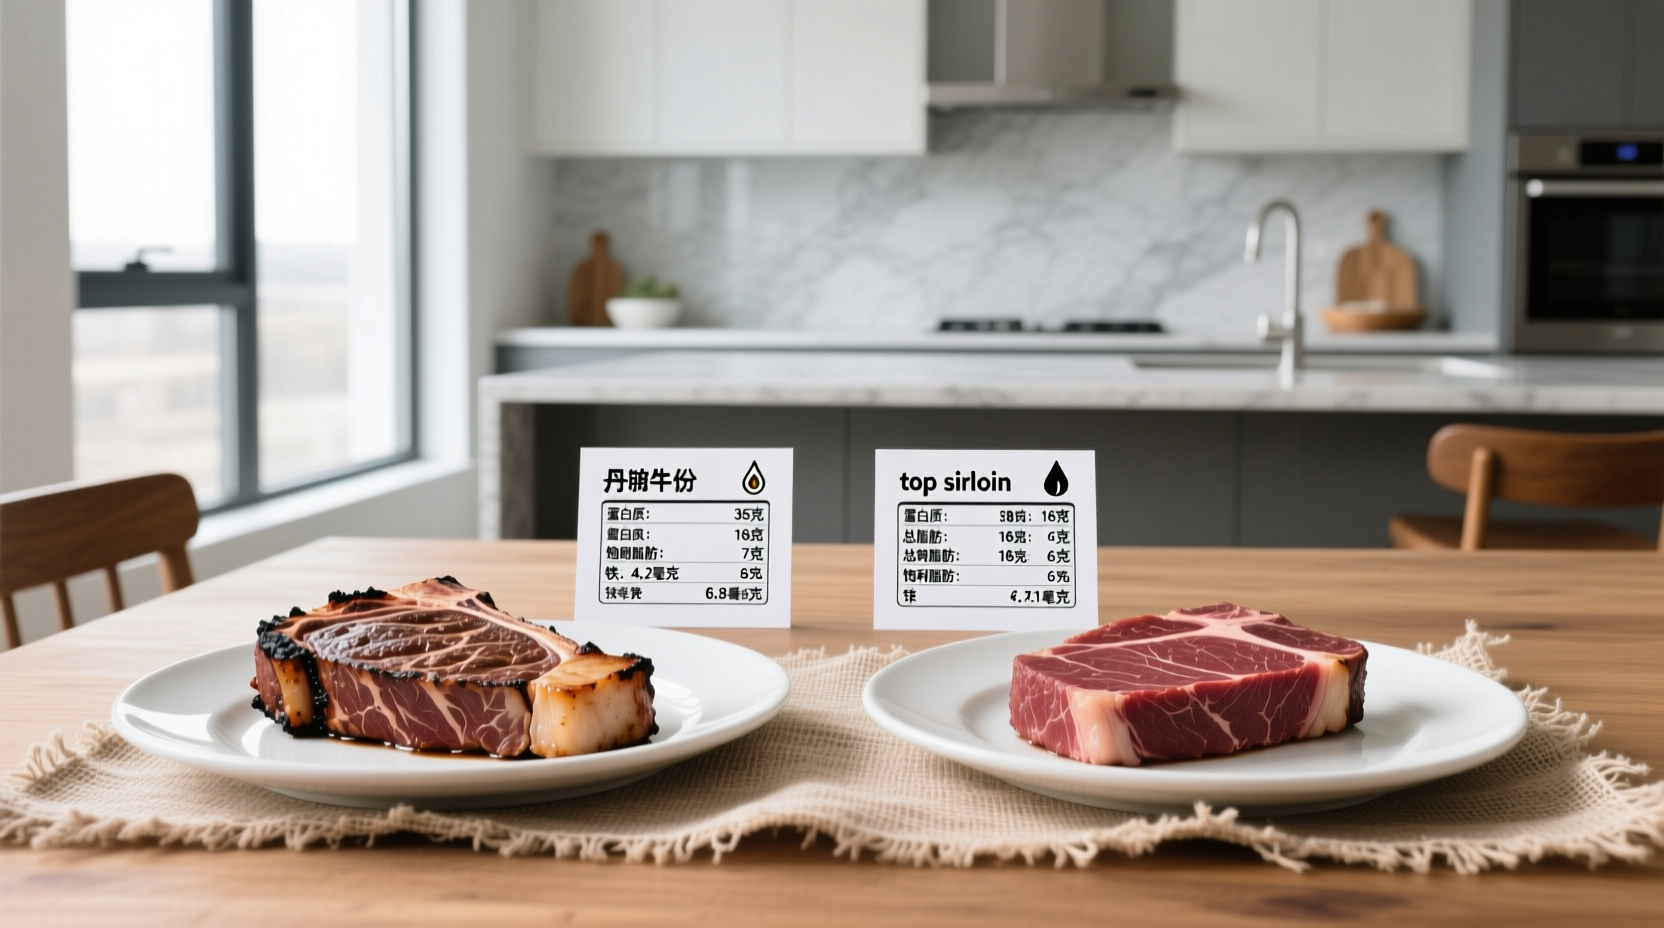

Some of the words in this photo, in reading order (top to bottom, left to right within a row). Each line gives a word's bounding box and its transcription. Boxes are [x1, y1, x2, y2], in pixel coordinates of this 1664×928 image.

[900, 472, 937, 497] top
[944, 470, 1011, 491] sirloin
[1042, 509, 1069, 523] 16克
[742, 546, 764, 561] 7克
[1047, 548, 1070, 563] 6克
